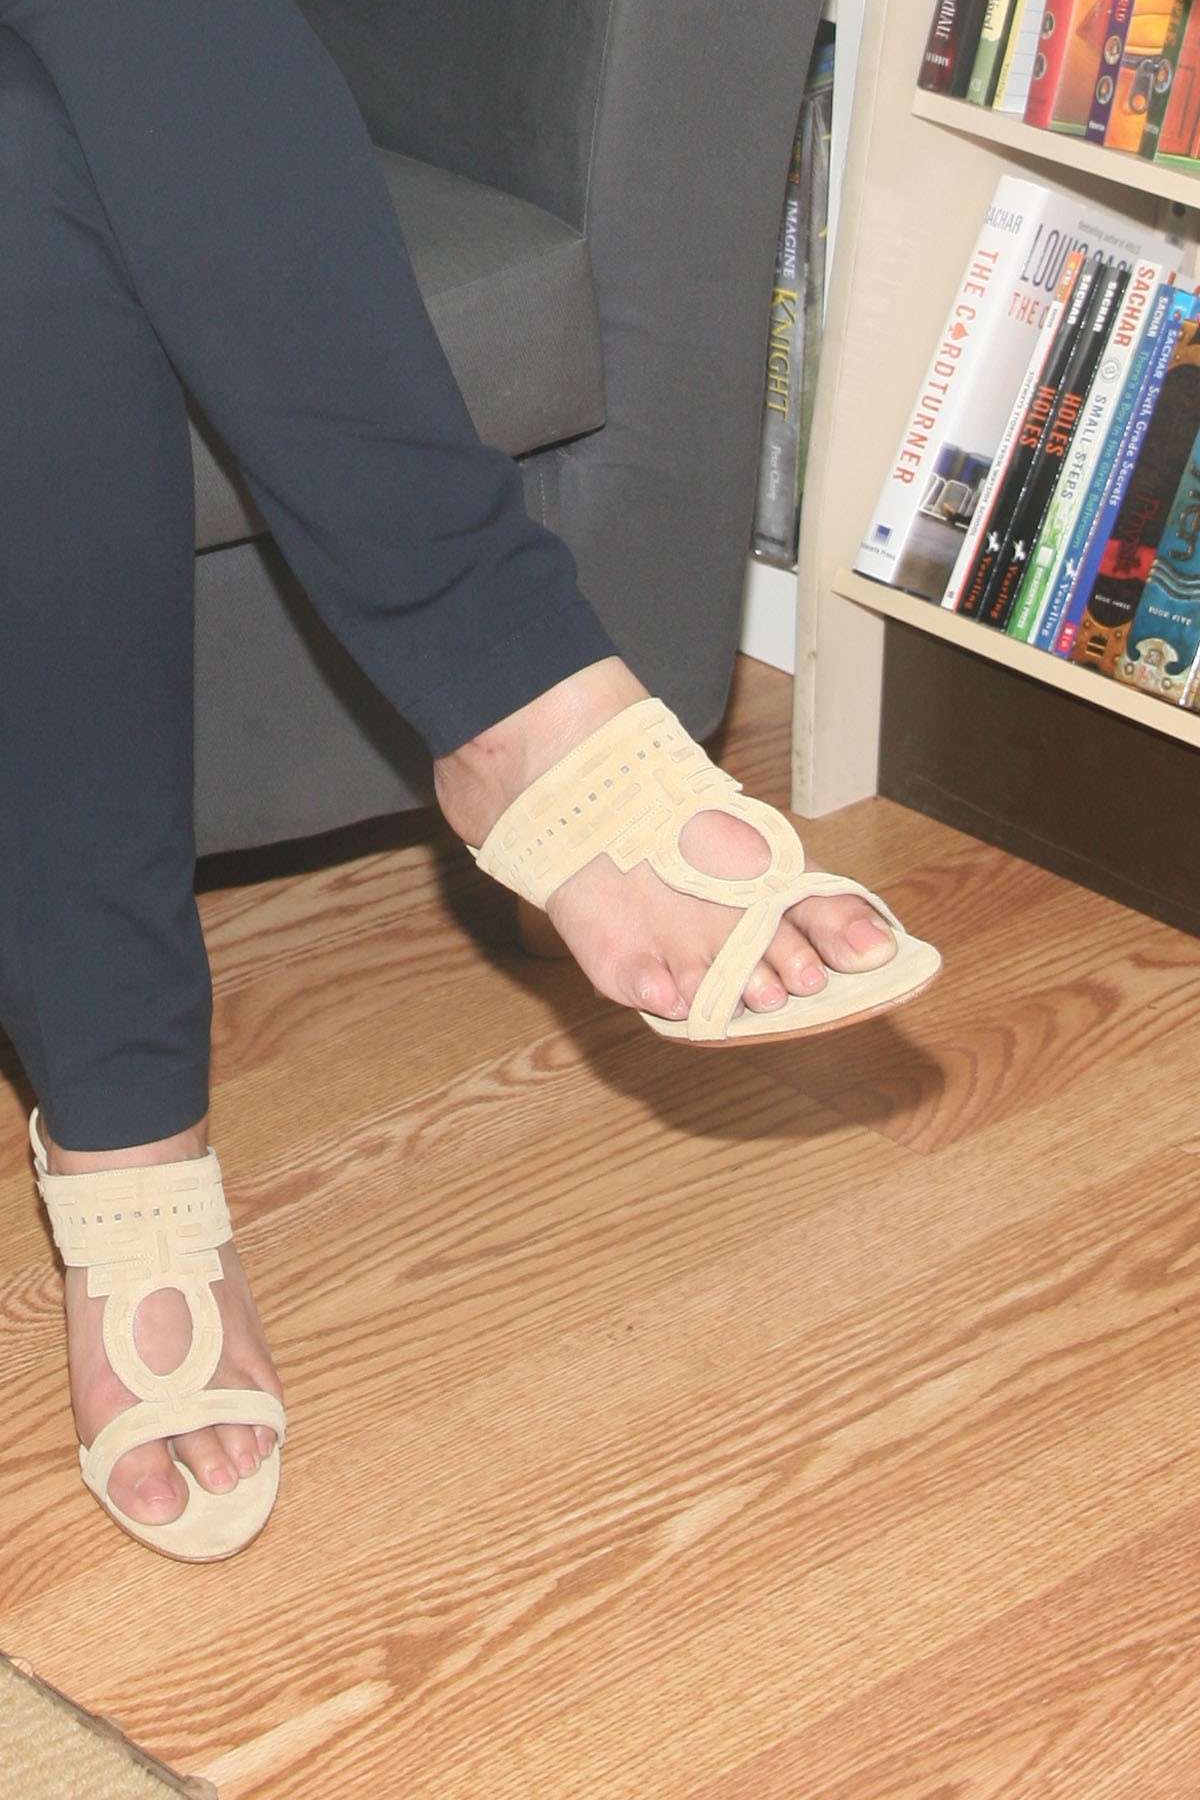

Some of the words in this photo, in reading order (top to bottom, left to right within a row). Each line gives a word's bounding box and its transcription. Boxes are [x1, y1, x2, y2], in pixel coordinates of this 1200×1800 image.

[784, 200, 798, 279] IMAGINE
[963, 247, 998, 298] THE
[1067, 273, 1092, 325] SACHAR
[1114, 265, 1155, 346] SACHAR
[765, 287, 797, 419] KNIGHT
[1020, 385, 1055, 449] HOLES
[1045, 392, 1082, 456] HOLES
[1081, 394, 1108, 454] SMALL
[1141, 385, 1160, 419] Sixth
[1127, 420, 1147, 460] Grade
[1062, 452, 1087, 499] STEPS
[1109, 461, 1134, 507] Secrets
